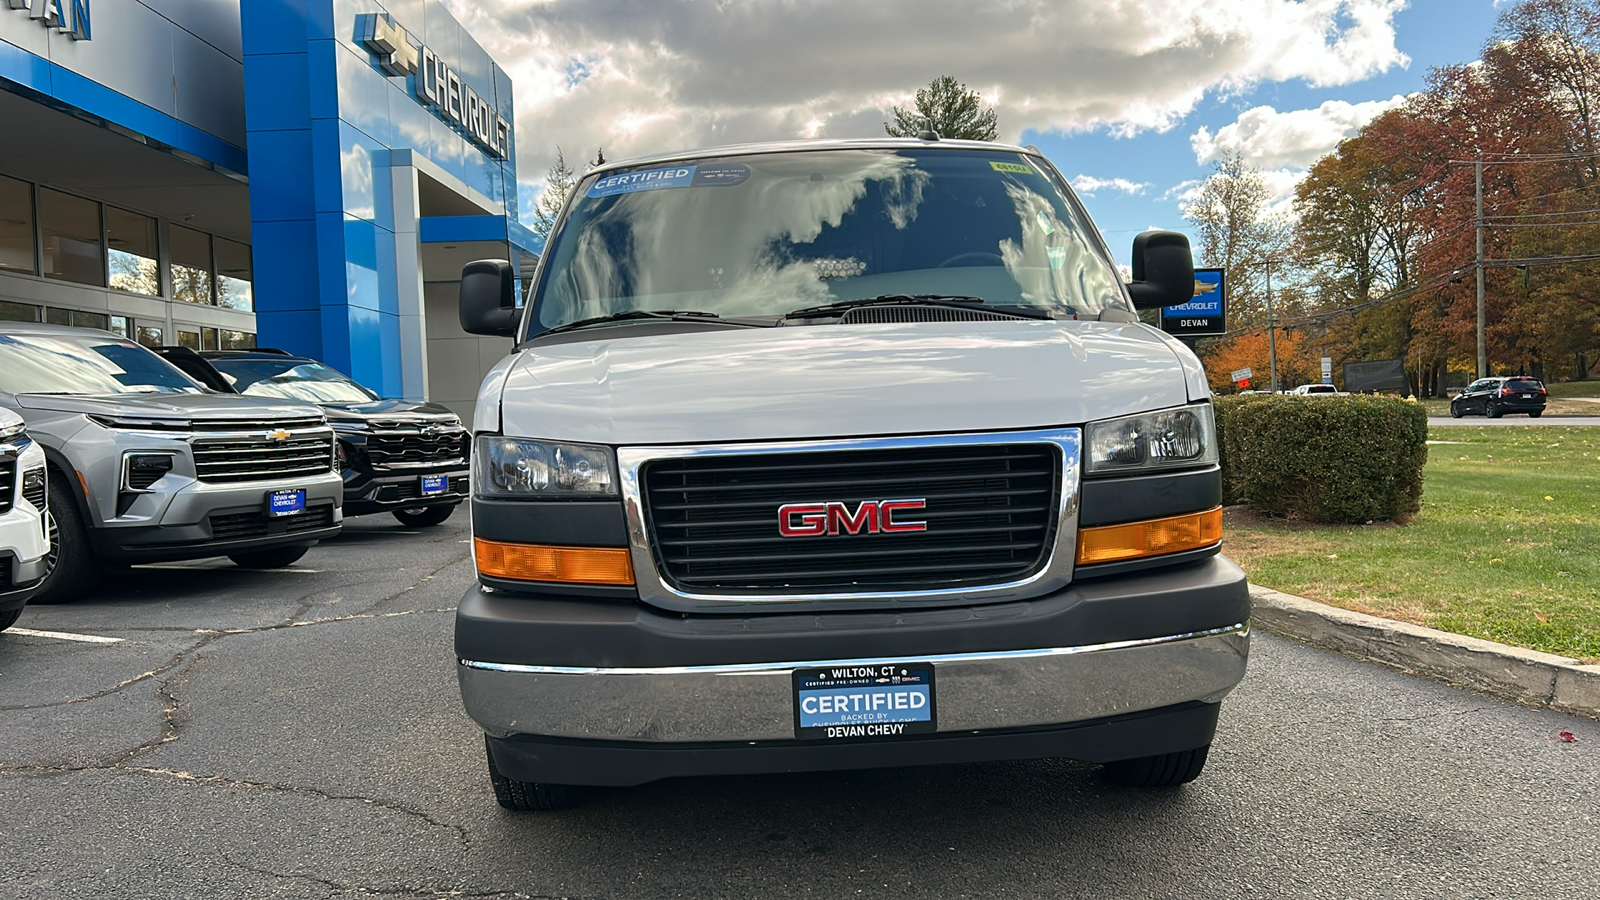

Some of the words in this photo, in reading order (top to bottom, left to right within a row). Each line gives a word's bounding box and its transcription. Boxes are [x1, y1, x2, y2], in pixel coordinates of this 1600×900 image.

[421, 45, 510, 161] CHEVROLET
[594, 169, 689, 190] CERTIFIED
[1169, 302, 1218, 311] CHEVROLET
[1181, 319, 1208, 327] DEVAN
[778, 498, 926, 538] GMC
[831, 667, 877, 679] WILTON,
[881, 666, 895, 676] CT
[802, 691, 926, 714] CERTIFIED
[841, 713, 874, 722] BACKED
[827, 726, 865, 738] DEVAN
[867, 723, 904, 736] CHEVY
